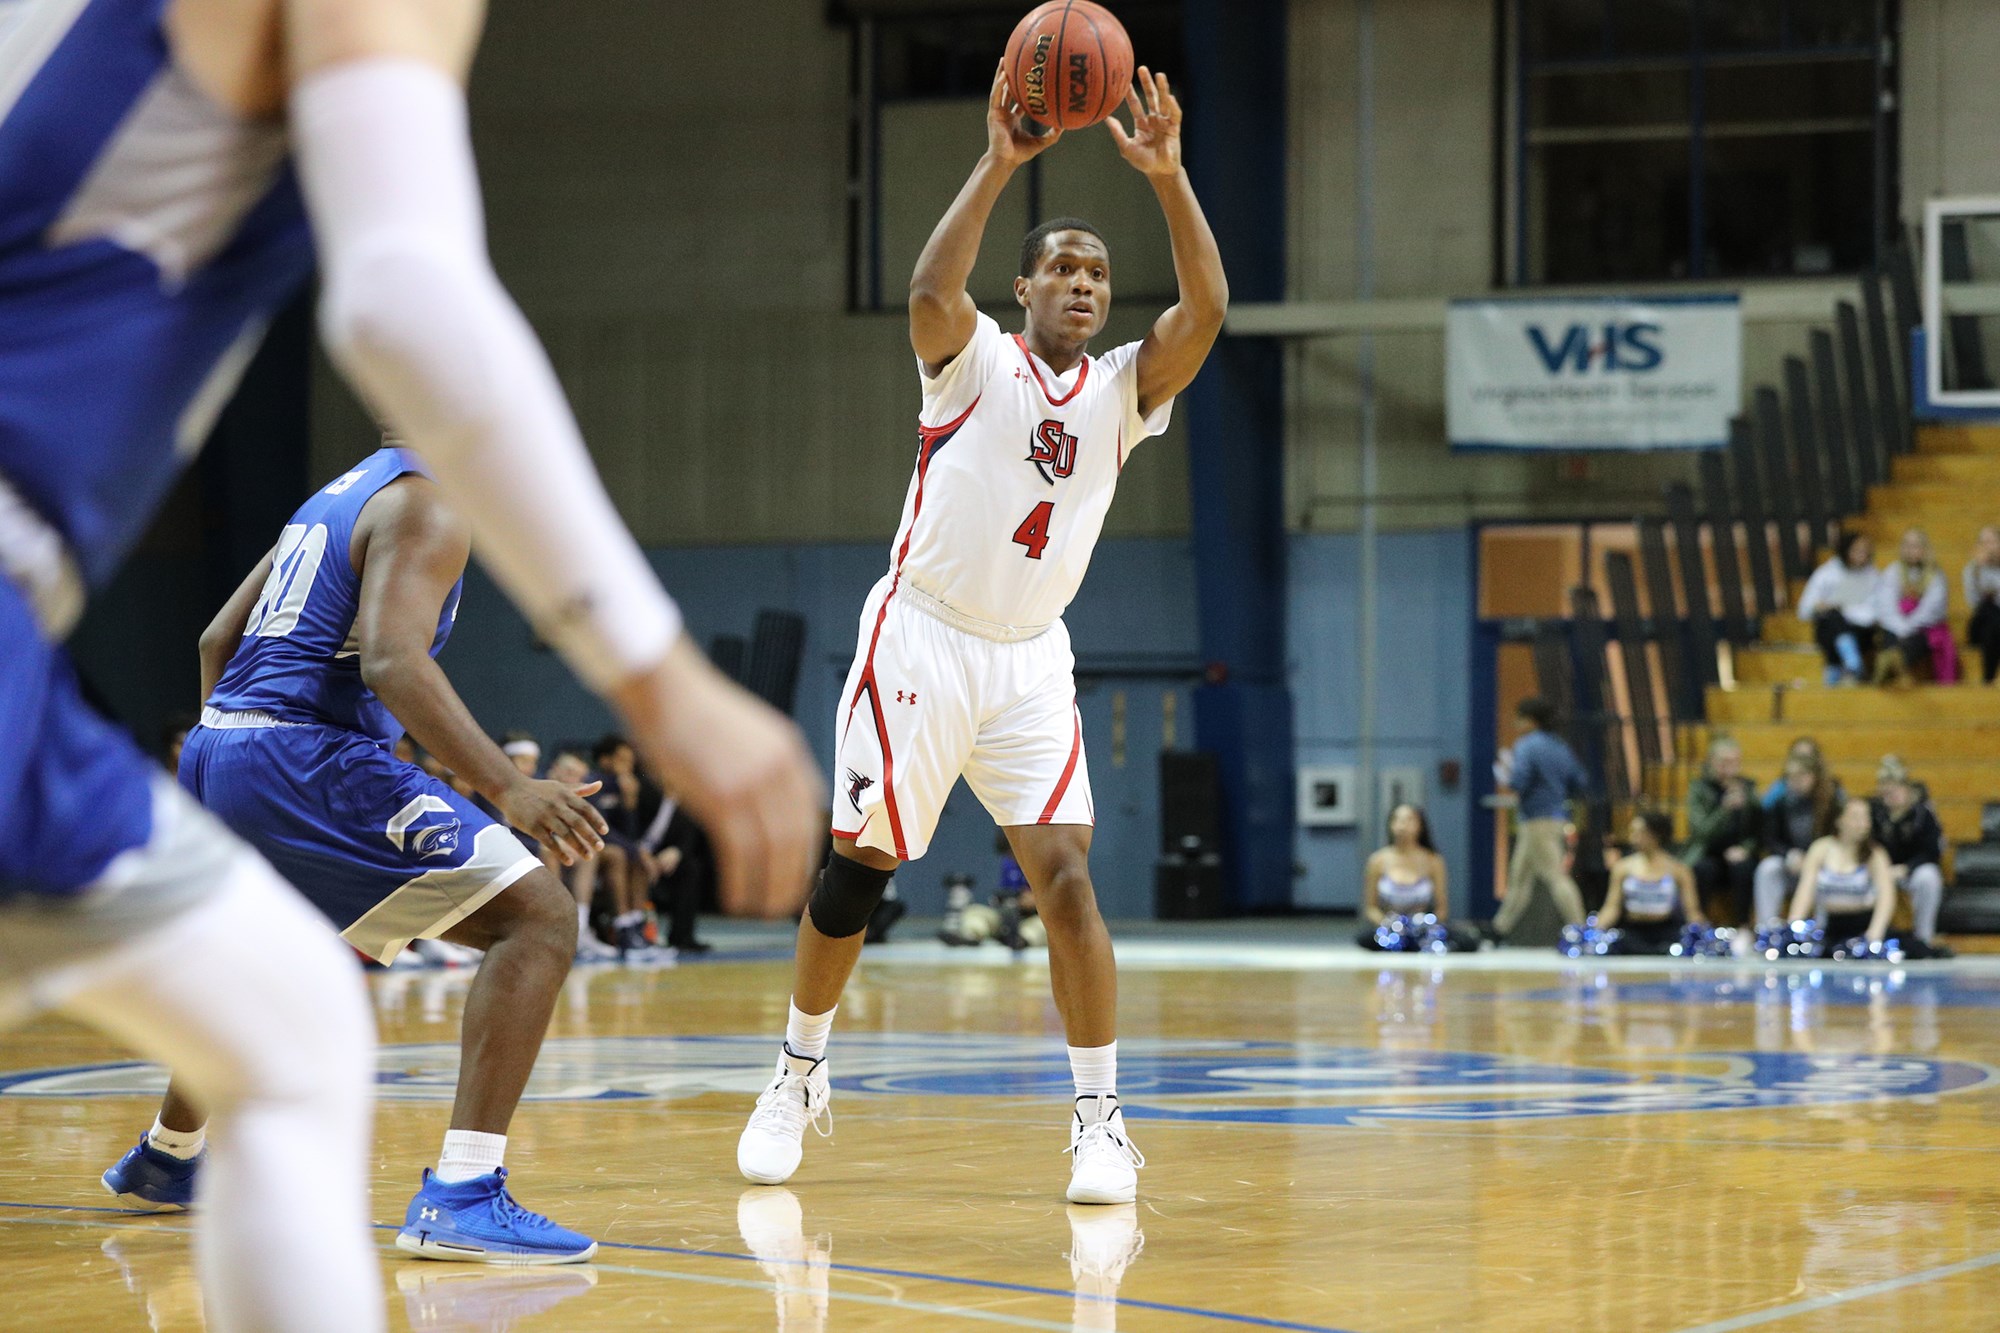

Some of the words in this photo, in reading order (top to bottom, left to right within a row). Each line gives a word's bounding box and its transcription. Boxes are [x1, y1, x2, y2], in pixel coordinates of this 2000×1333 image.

[1024, 33, 1056, 117] Wilson
[1068, 53, 1088, 114] NCAA
[1526, 321, 1664, 375] VHS
[1028, 419, 1079, 478] SU
[1012, 501, 1055, 560] 4
